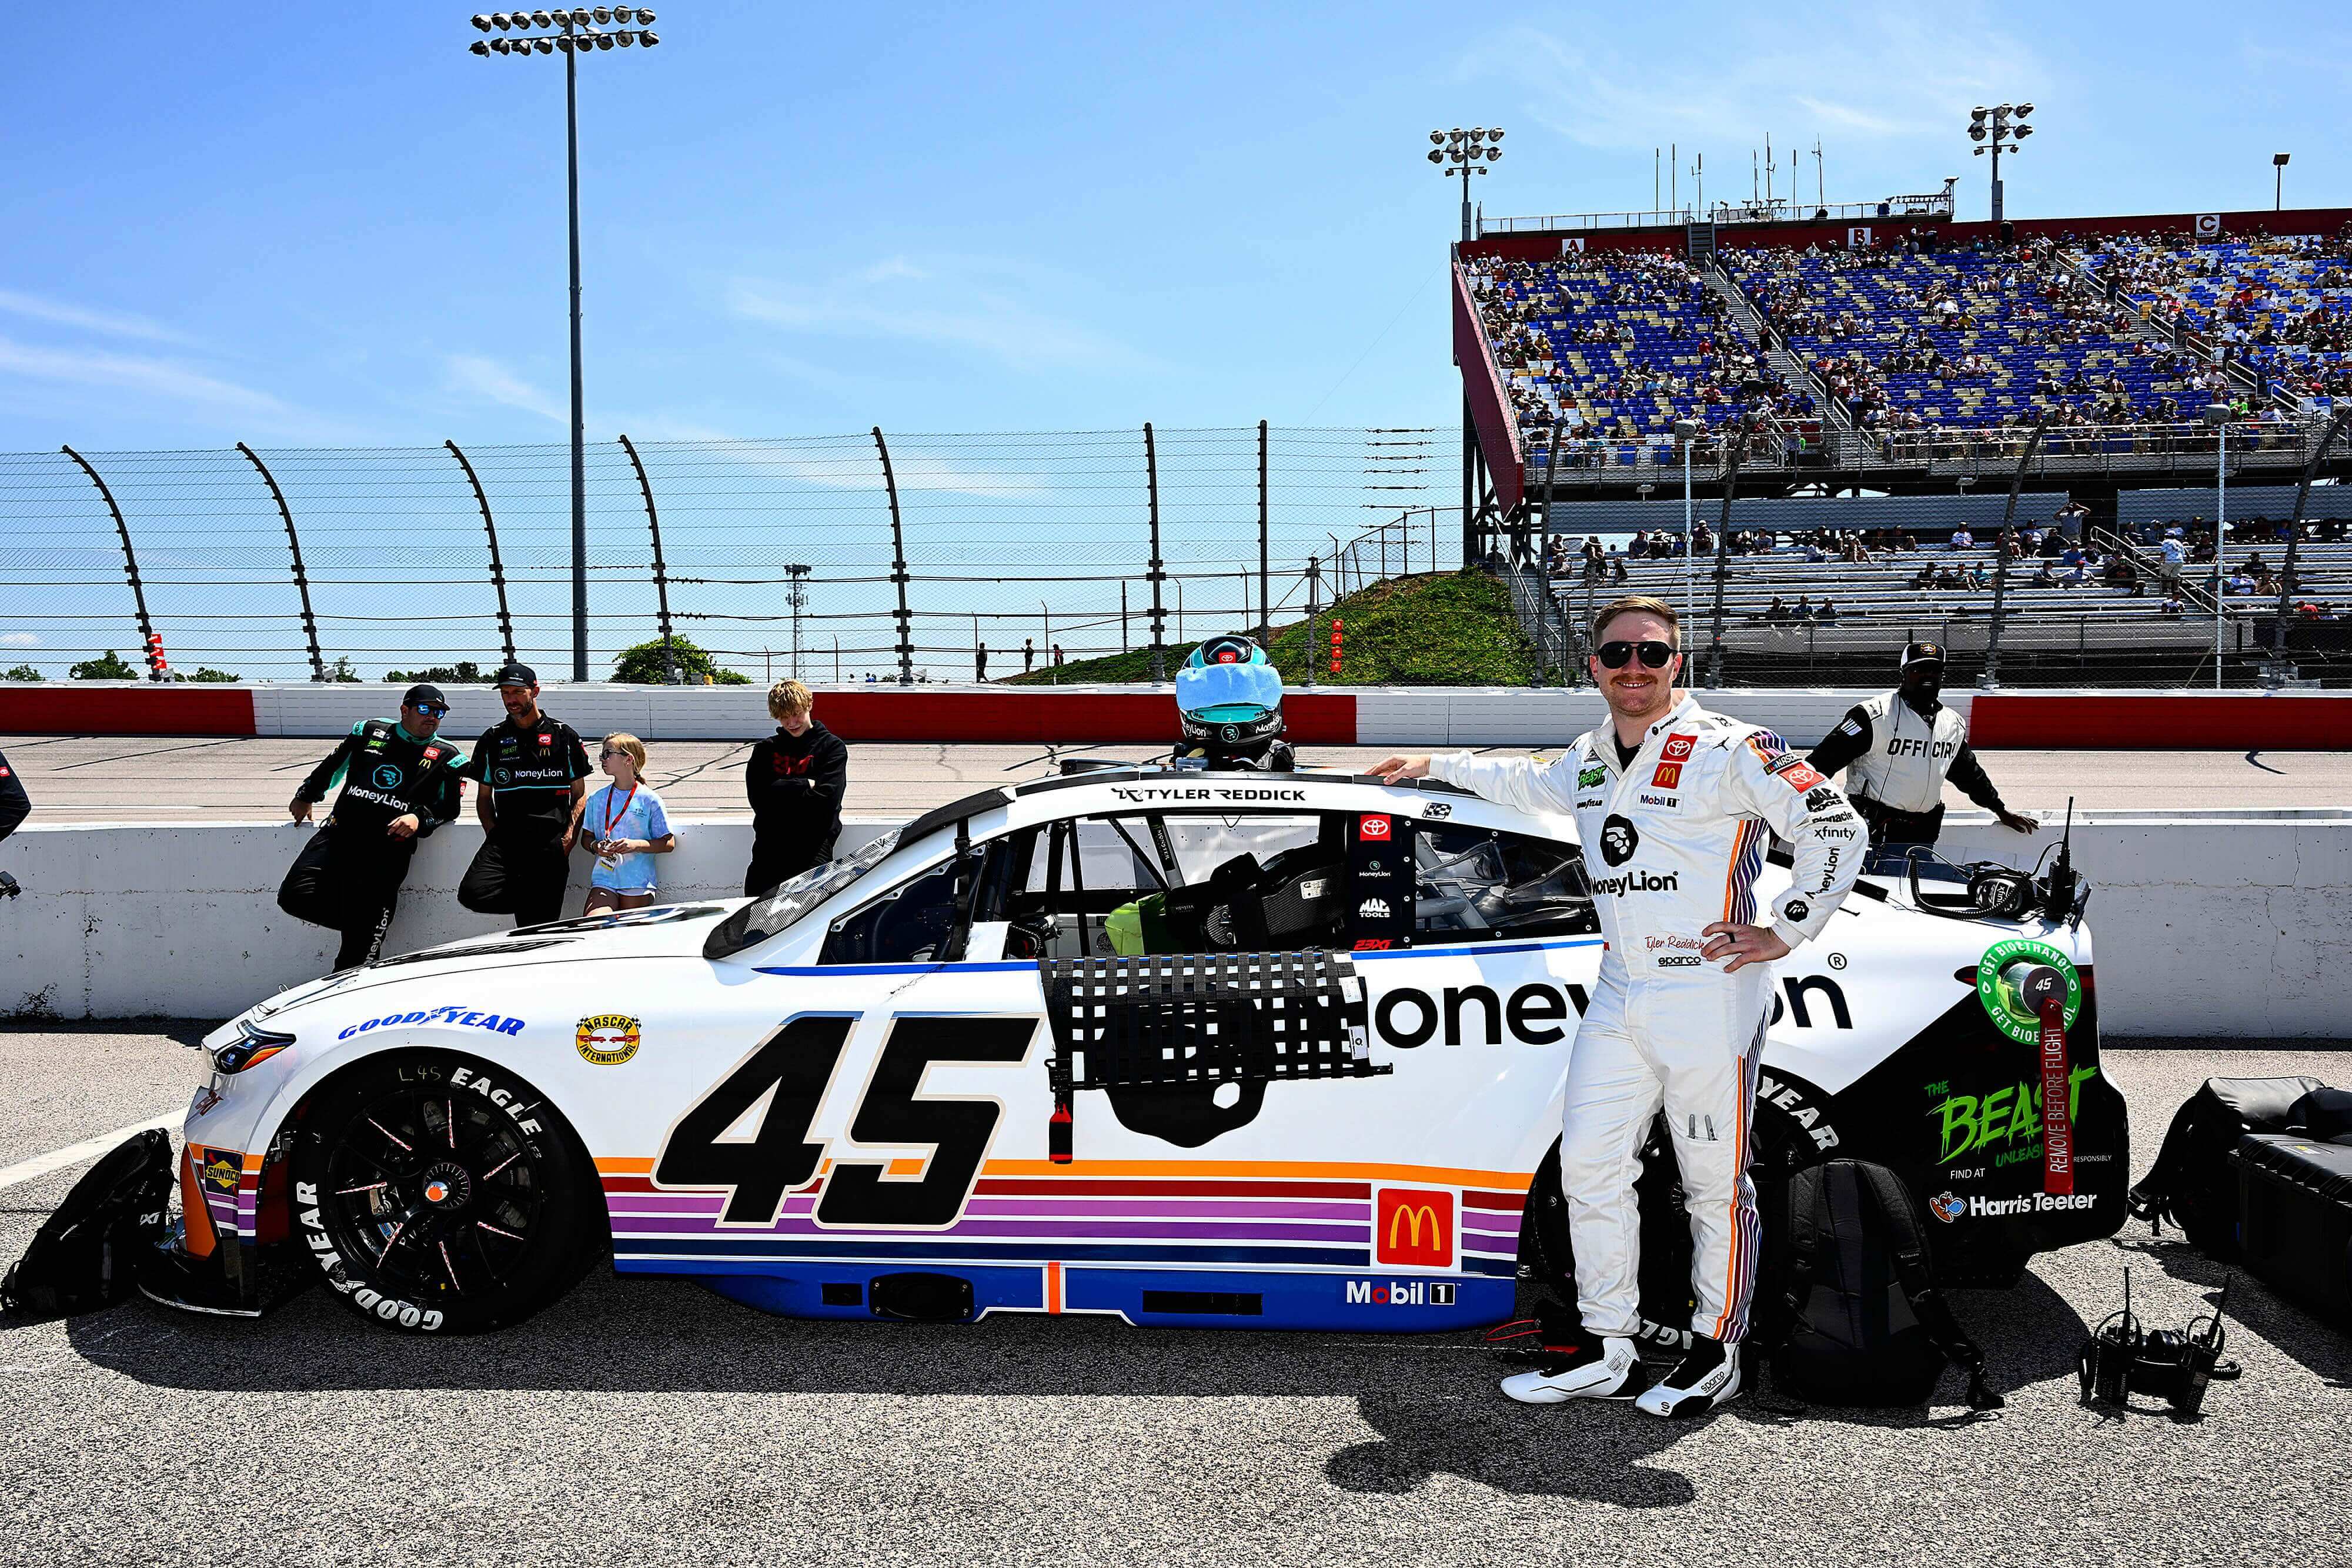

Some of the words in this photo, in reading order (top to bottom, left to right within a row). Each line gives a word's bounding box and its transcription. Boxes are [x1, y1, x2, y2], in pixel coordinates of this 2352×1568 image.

[2199, 216, 2216, 231] C
[1853, 229, 1866, 244] B
[1565, 239, 1581, 255] A
[515, 768, 563, 780] MoneyLion
[1579, 765, 1607, 787] BEAST
[347, 785, 410, 812] MoneyLion
[1144, 789, 1211, 800] TYLER
[1214, 788, 1307, 801] REDDICK
[1640, 794, 1665, 806] Mobil
[1814, 825, 1857, 841] xfinity
[1359, 898, 1391, 912] MAC
[1645, 936, 1665, 952] Tyler
[1658, 956, 1701, 967] sparco
[1981, 952, 1999, 977] GET
[2035, 977, 2053, 991] 45
[338, 1006, 526, 1040] GOODYEAR
[583, 1016, 633, 1034] NASCAR
[1991, 1006, 2012, 1029] GET
[579, 1044, 636, 1063] INTERNATIONAL
[2044, 1027, 2064, 1069] FLIGHT
[1924, 1080, 1950, 1097] THE
[2046, 1071, 2066, 1121] BEFORE
[450, 1066, 543, 1136] EAGLE
[650, 1011, 1047, 1231] 45
[1994, 1145, 2044, 1167] UNLEAS
[2048, 1124, 2069, 1173] REMOVE
[2073, 1154, 2113, 1163] RESPONSIBLY
[207, 1166, 241, 1183] SUNOCO
[1950, 1169, 1972, 1180] FIND
[1973, 1168, 1986, 1179] AT
[1970, 1194, 2032, 1217] Harris
[2032, 1192, 2097, 1212] Teeter
[1346, 1281, 1424, 1305] Mobil
[1700, 1370, 1726, 1394] sparco
